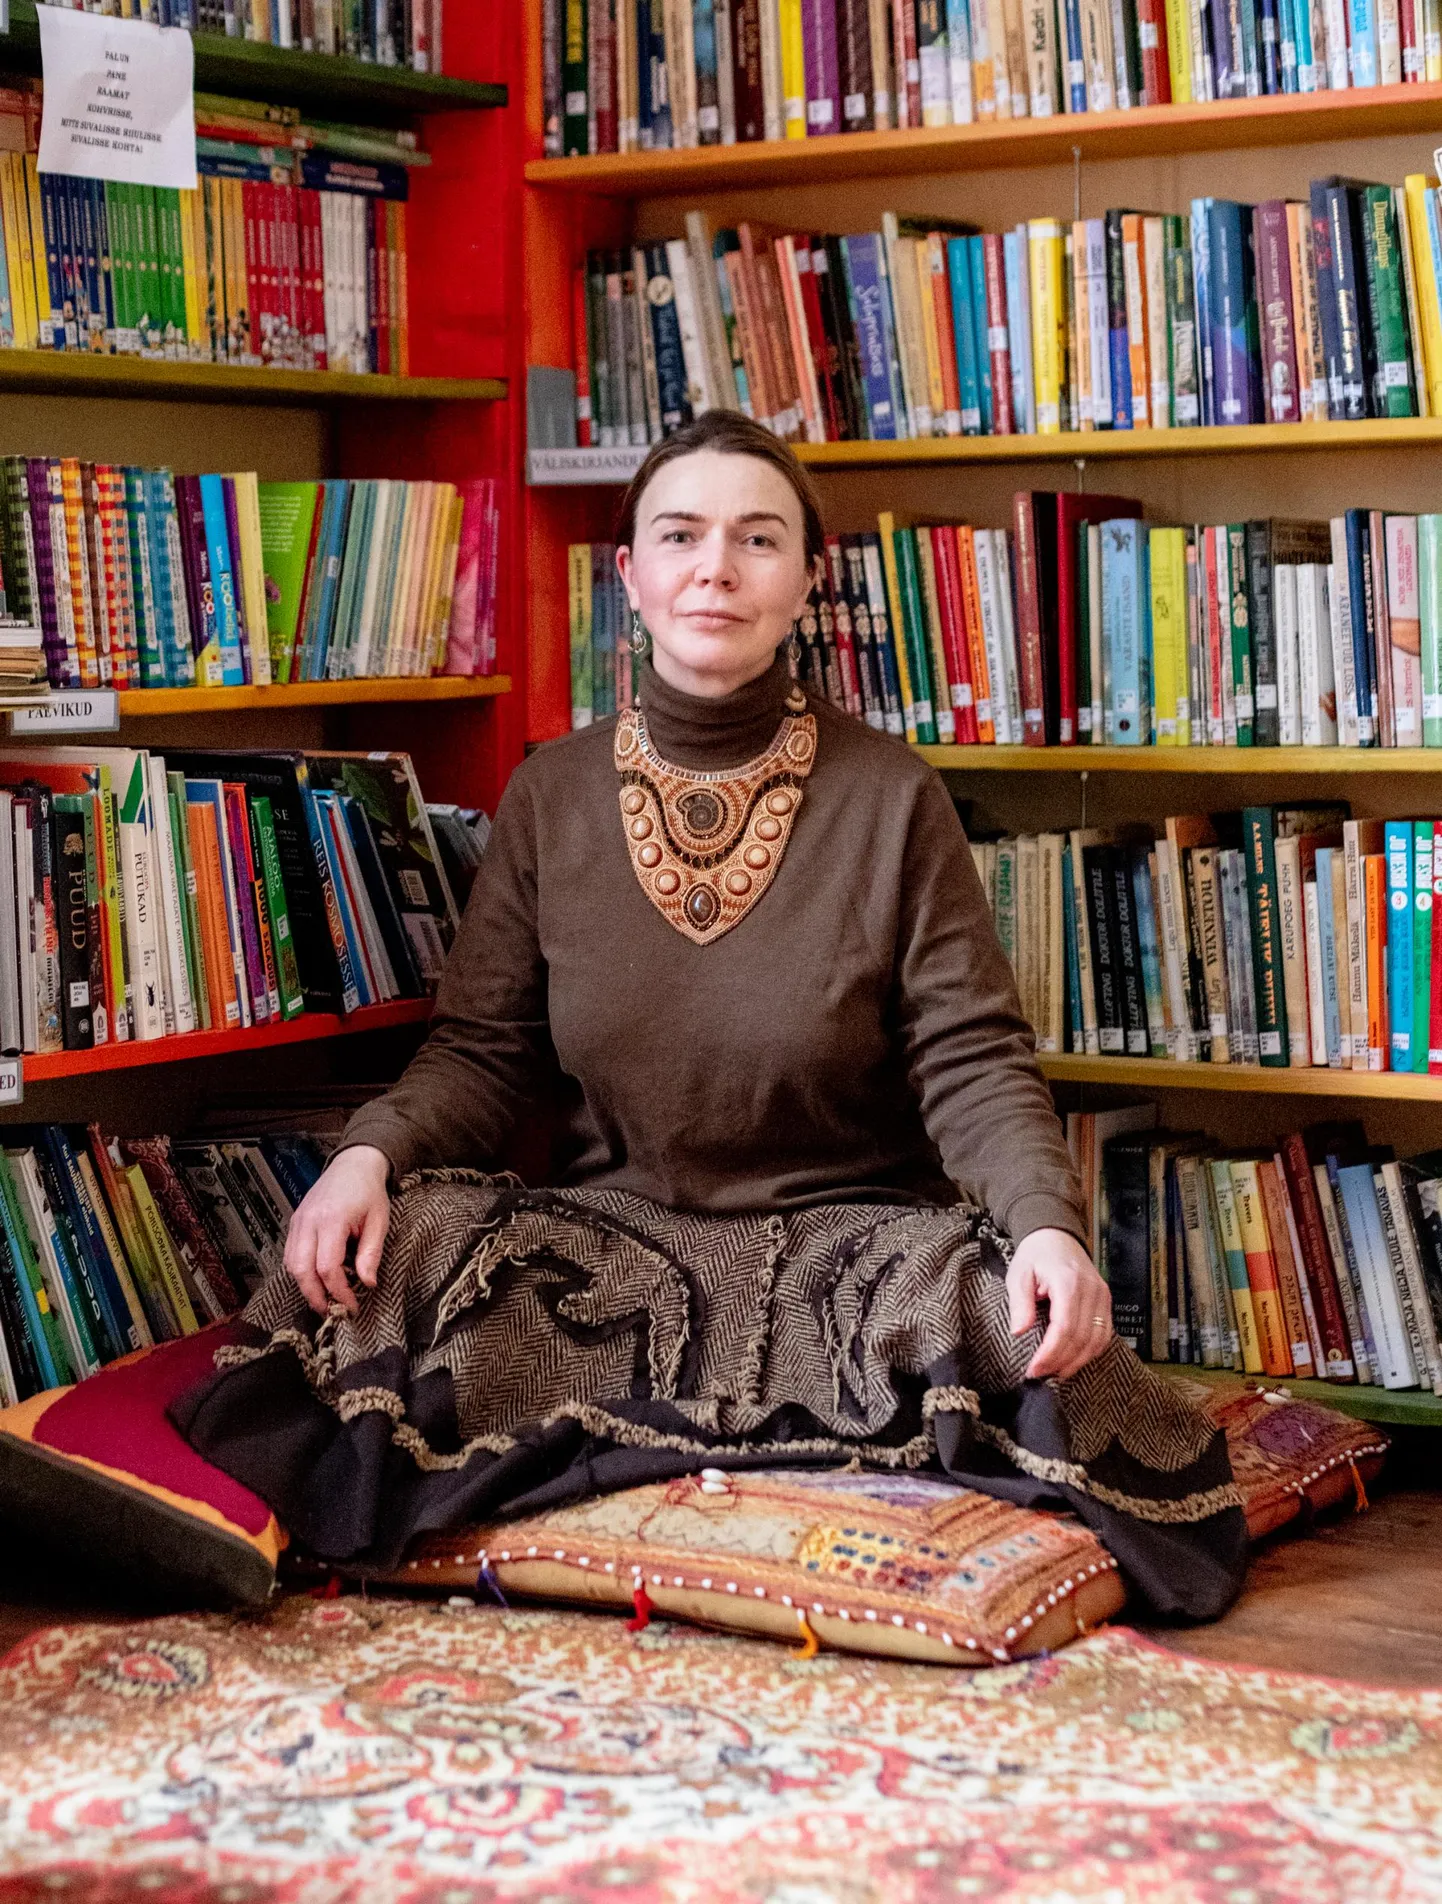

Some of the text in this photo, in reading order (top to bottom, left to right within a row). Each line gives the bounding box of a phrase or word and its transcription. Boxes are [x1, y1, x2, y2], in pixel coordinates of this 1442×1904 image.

[104, 51, 130, 63] PALUN
[106, 69, 127, 81] PANE
[96, 87, 130, 100] RAAMAT
[103, 788, 114, 852] LOOMADE
[86, 815, 96, 884] PUUD
[69, 871, 87, 949] PUUD
[135, 853, 147, 923] PUTUKAD
[165, 831, 187, 997] MAAILMA IMETAJATE MITMEKESISUS
[313, 838, 356, 993] REIS KOSMOSESSE
[1281, 863, 1295, 960] KARUPOEG PUHH
[67, 1159, 85, 1204] SAURUSED
[1243, 1194, 1252, 1223] Travers
[1388, 1235, 1404, 1267] TUULE
[1397, 1270, 1413, 1303] NELJA
[1405, 1305, 1421, 1338] MAJA
